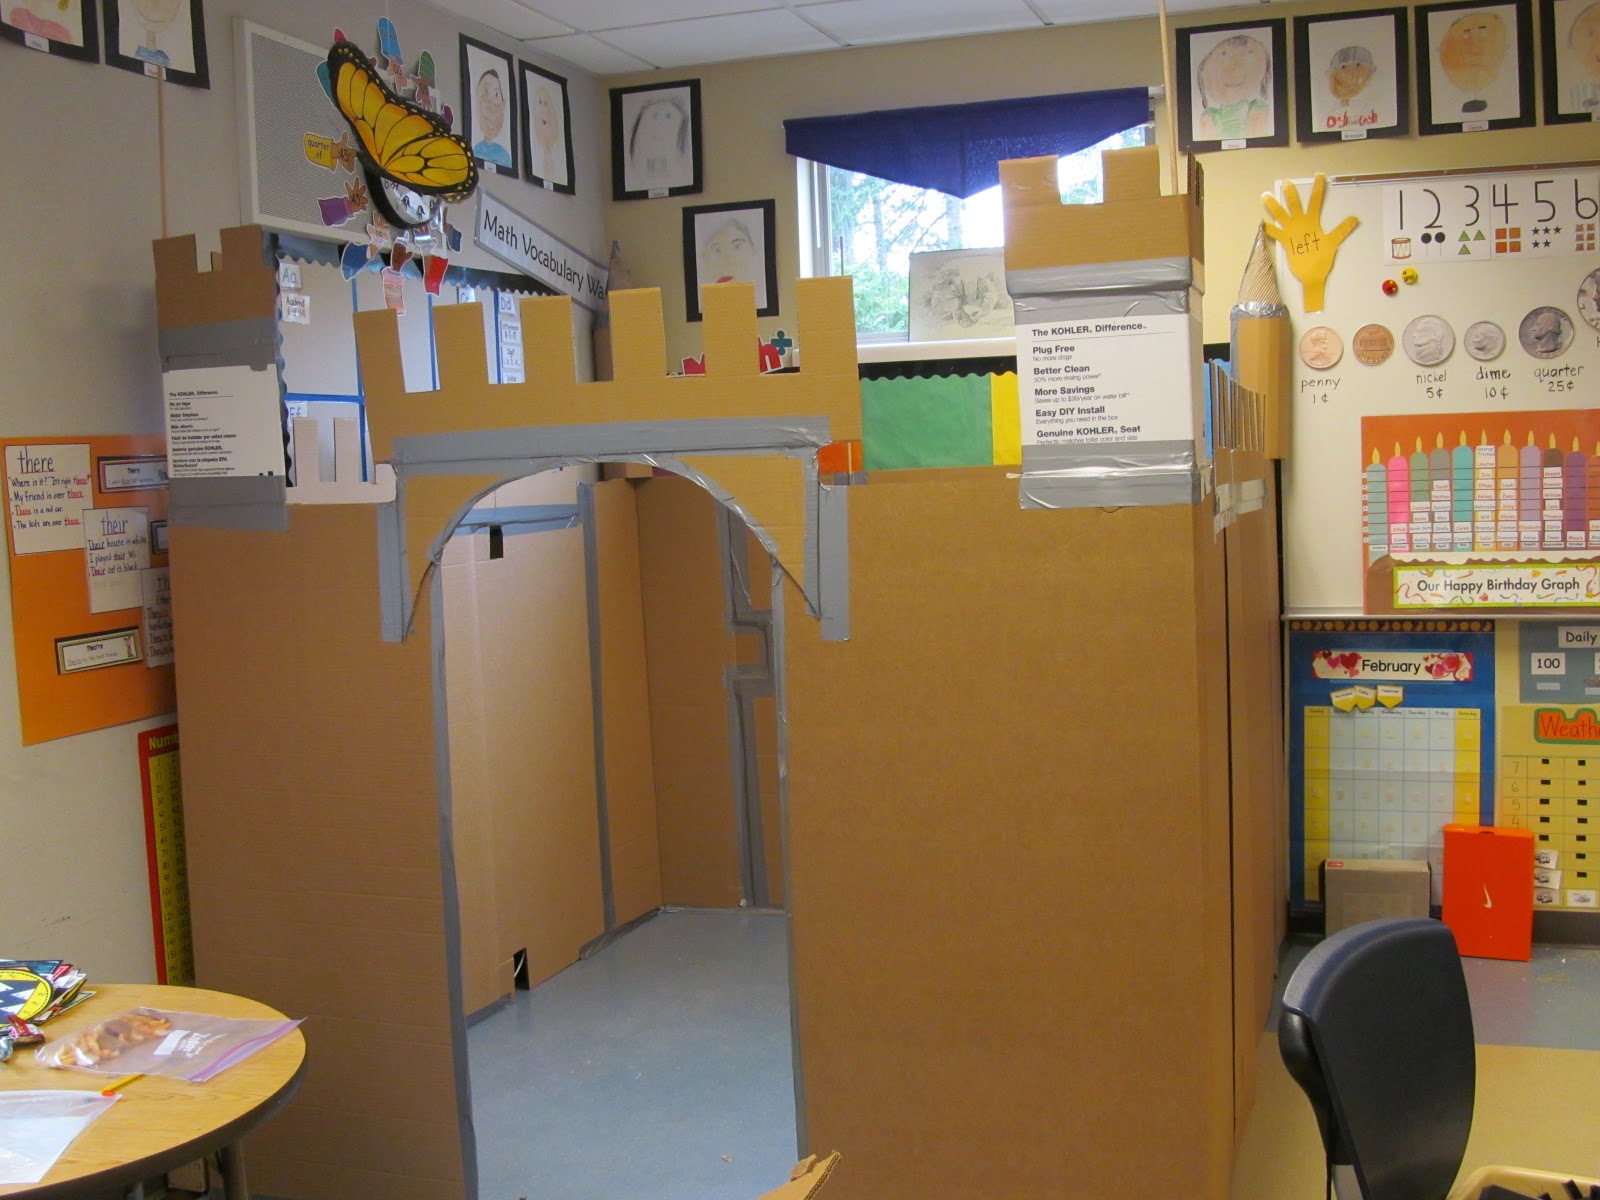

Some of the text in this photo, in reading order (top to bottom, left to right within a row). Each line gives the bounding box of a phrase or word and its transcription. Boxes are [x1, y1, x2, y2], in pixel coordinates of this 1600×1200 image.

[308, 140, 329, 150] quarter
[316, 151, 322, 159] of
[1400, 178, 1599, 230] 1 2 3 4 5 6
[1290, 232, 1320, 255] left
[484, 210, 518, 249] Math
[522, 233, 584, 292] Vocabulary
[283, 268, 297, 284] Aa
[501, 298, 512, 310] Dd
[1033, 346, 1052, 354] Plug
[1034, 365, 1090, 375] Better Clean
[1476, 366, 1511, 380] dime
[1534, 363, 1585, 383] quarter
[1416, 370, 1447, 384] nickel
[1060, 386, 1095, 395] Savings
[1301, 378, 1341, 393] penny
[1036, 406, 1105, 418] Easy DIY Install
[1036, 430, 1074, 438] Genuine
[1120, 425, 1141, 433] Seat
[17, 444, 55, 473] there
[61, 478, 72, 488] right
[14, 493, 24, 505] My
[25, 492, 45, 501] friend
[16, 521, 27, 529] The
[28, 519, 40, 528] kids
[101, 510, 128, 535] their
[88, 539, 105, 550] Their
[106, 539, 124, 548] house
[95, 552, 112, 566] played
[114, 551, 126, 560] their
[90, 566, 106, 576] Their
[1417, 577, 1580, 594] Our Happy Birthday Graph
[1565, 631, 1598, 645] Daily
[1362, 659, 1421, 675] February
[1537, 658, 1560, 669] 100
[1512, 761, 1520, 774] 7
[1512, 780, 1519, 793] 6
[1512, 799, 1520, 811] 5
